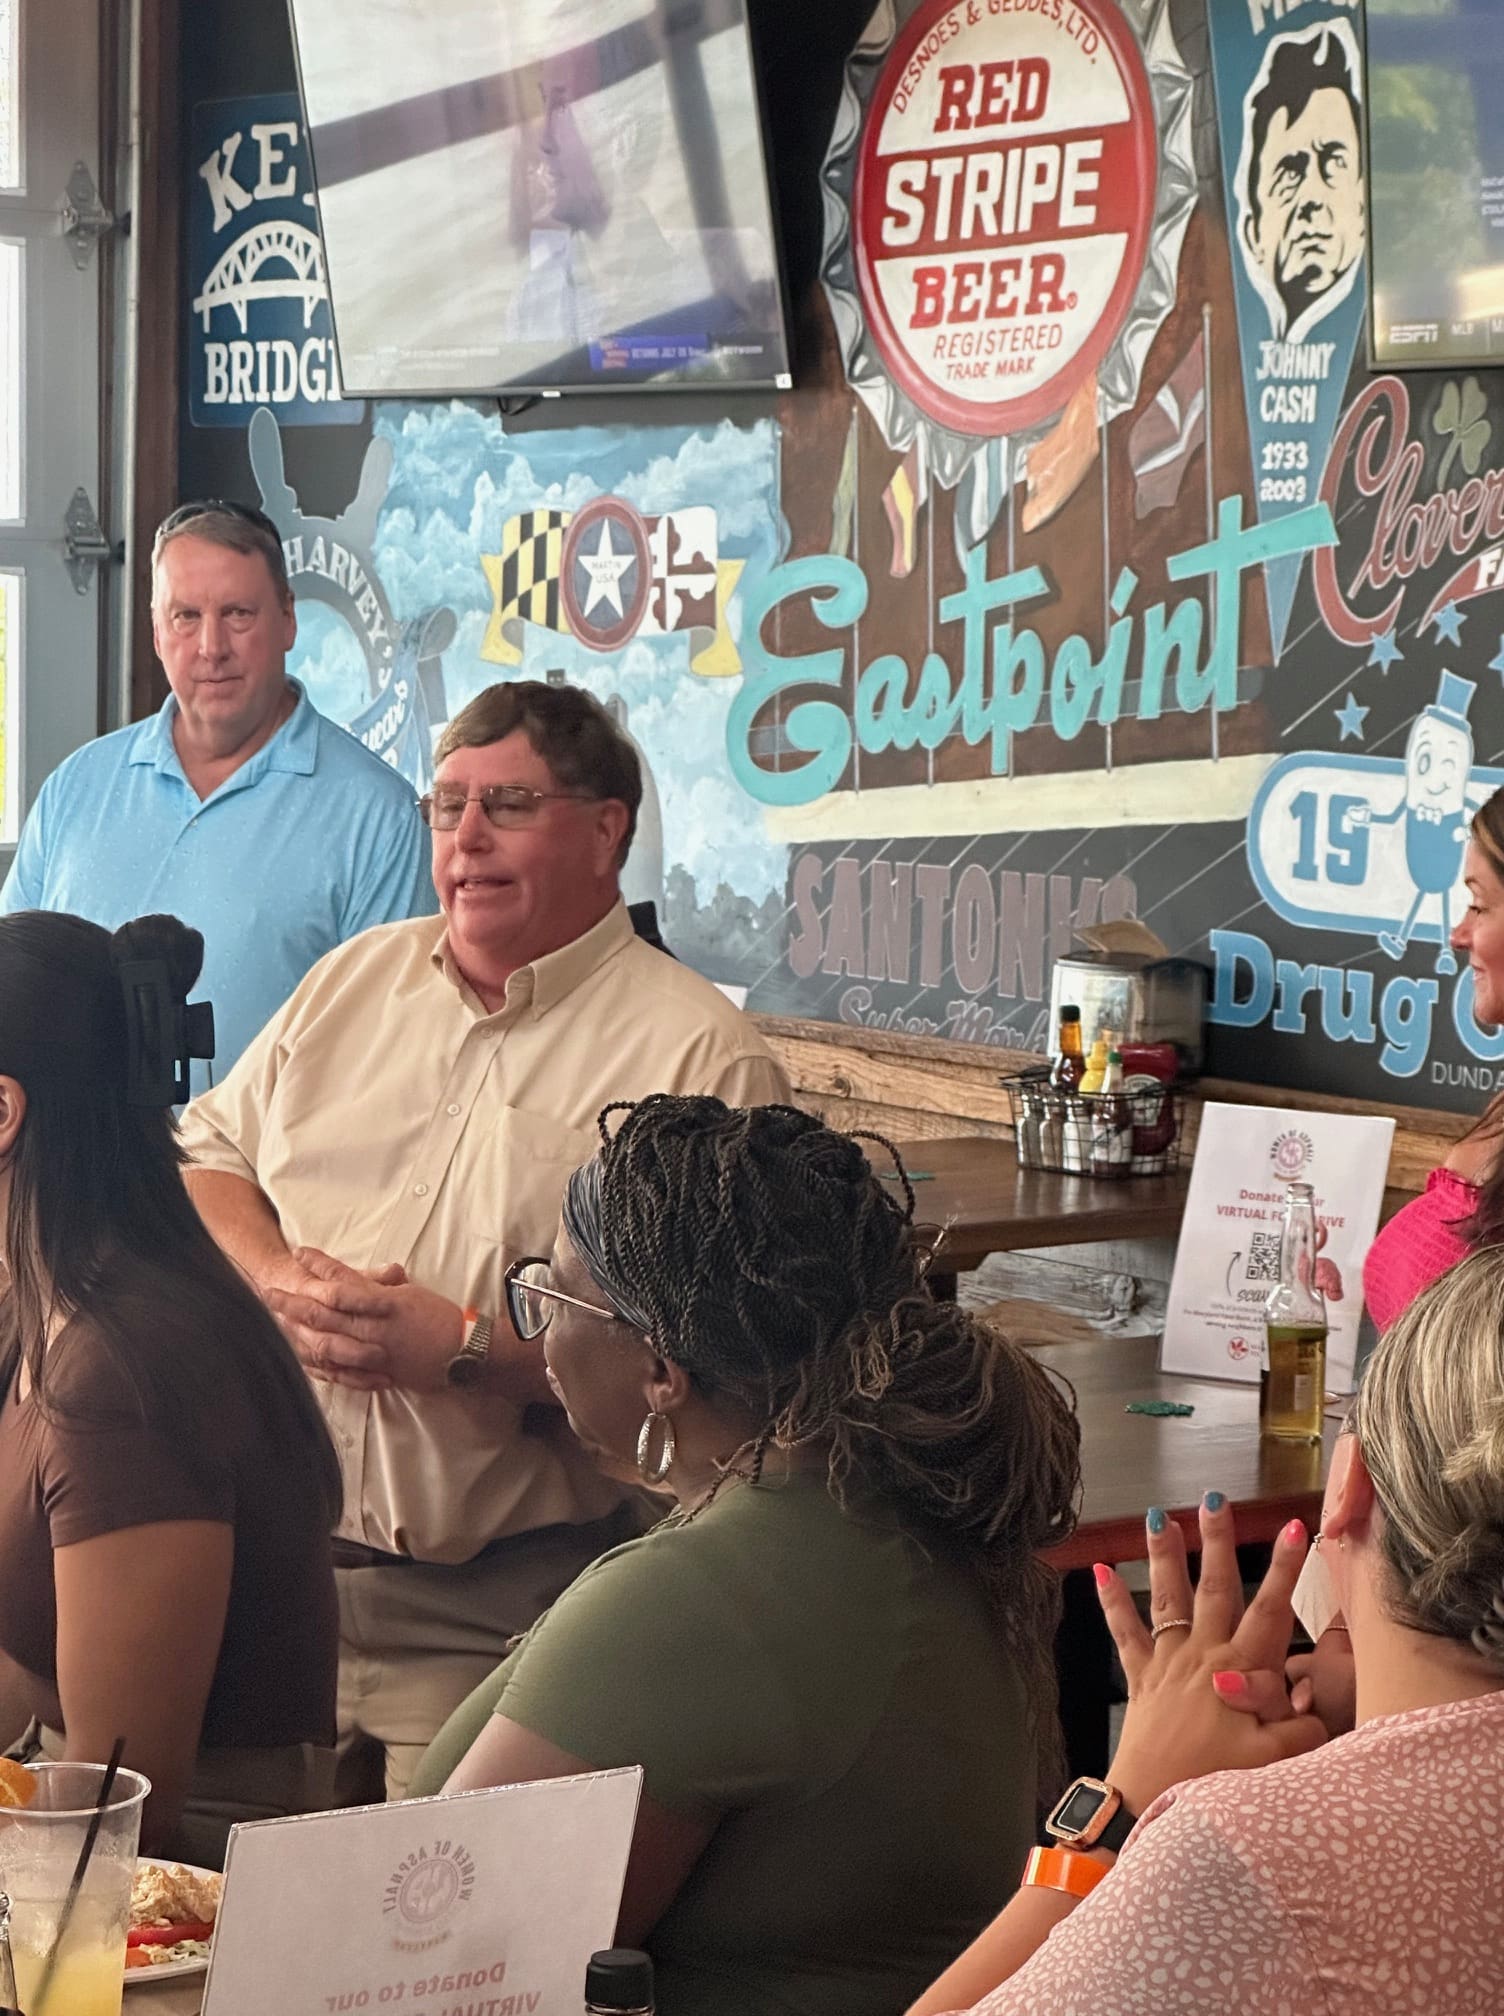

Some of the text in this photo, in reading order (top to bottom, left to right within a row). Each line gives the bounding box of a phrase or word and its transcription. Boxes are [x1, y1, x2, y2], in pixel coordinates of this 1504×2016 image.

[893, 13, 960, 114] DESNOES
[967, 0, 982, 26] &
[1065, 11, 1098, 65] LTD.
[934, 57, 1050, 133] RED
[200, 122, 316, 234] KE
[882, 139, 1103, 246] STRIPE
[934, 323, 1062, 359] REGISTERED
[1256, 341, 1336, 380] JOHNNY
[947, 357, 1035, 381] TRADE MARK
[1260, 386, 1317, 423] CASH
[1261, 442, 1309, 470] 1933
[1260, 477, 1306, 501] 2003
[726, 494, 1341, 807] Eastpoint
[1288, 790, 1370, 886] 15
[1206, 929, 1439, 1078] Drug
[1240, 1189, 1284, 1203] Donate
[1216, 1205, 1268, 1220] VIRTUAL
[1317, 1215, 1346, 1228] RIVE
